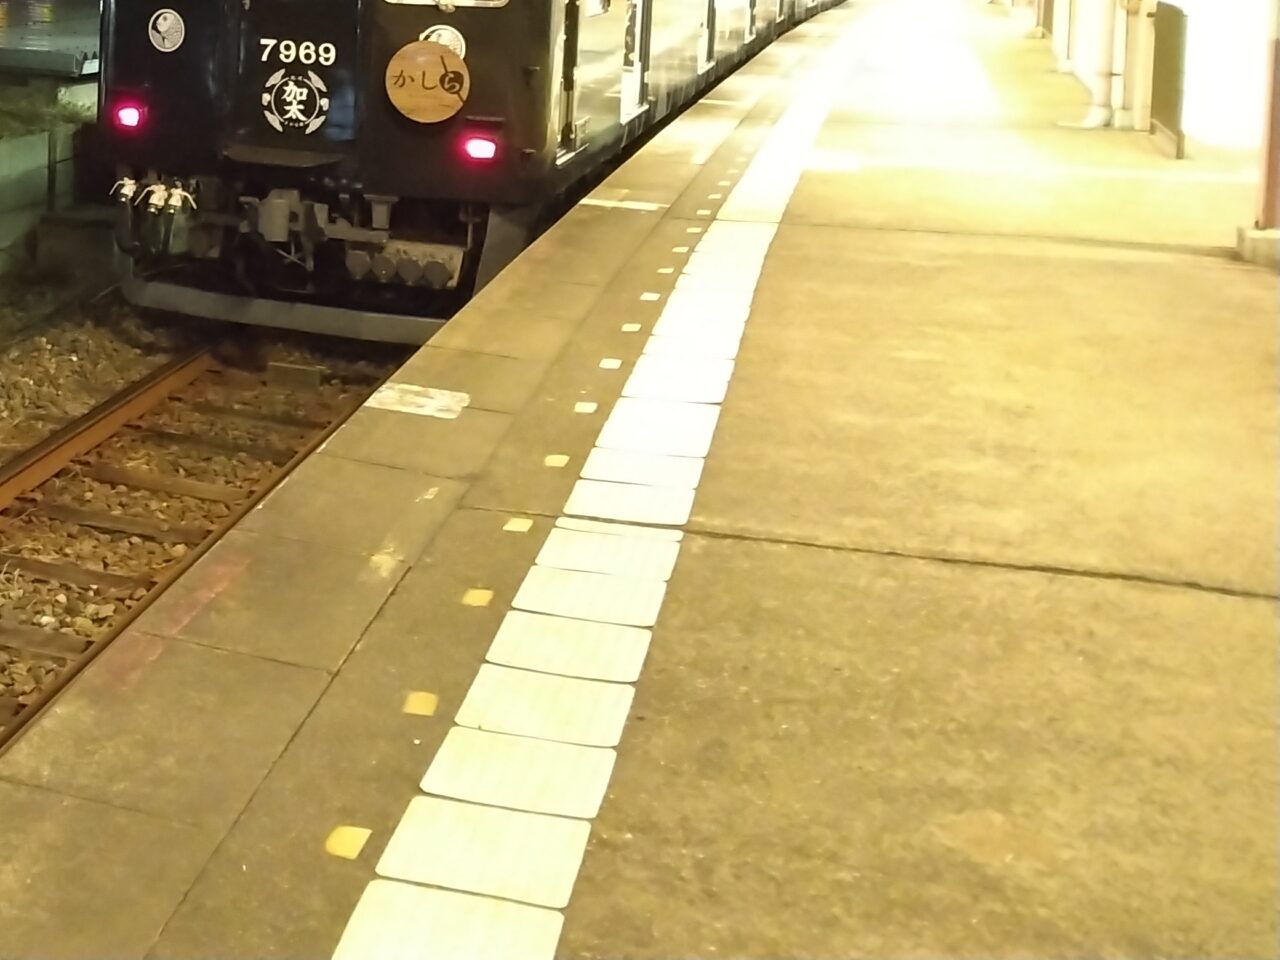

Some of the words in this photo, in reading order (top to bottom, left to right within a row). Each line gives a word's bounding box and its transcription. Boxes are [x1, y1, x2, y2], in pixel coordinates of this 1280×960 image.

[260, 38, 337, 66] 7969
[392, 69, 461, 93] かしら
[280, 80, 309, 122] 加太
